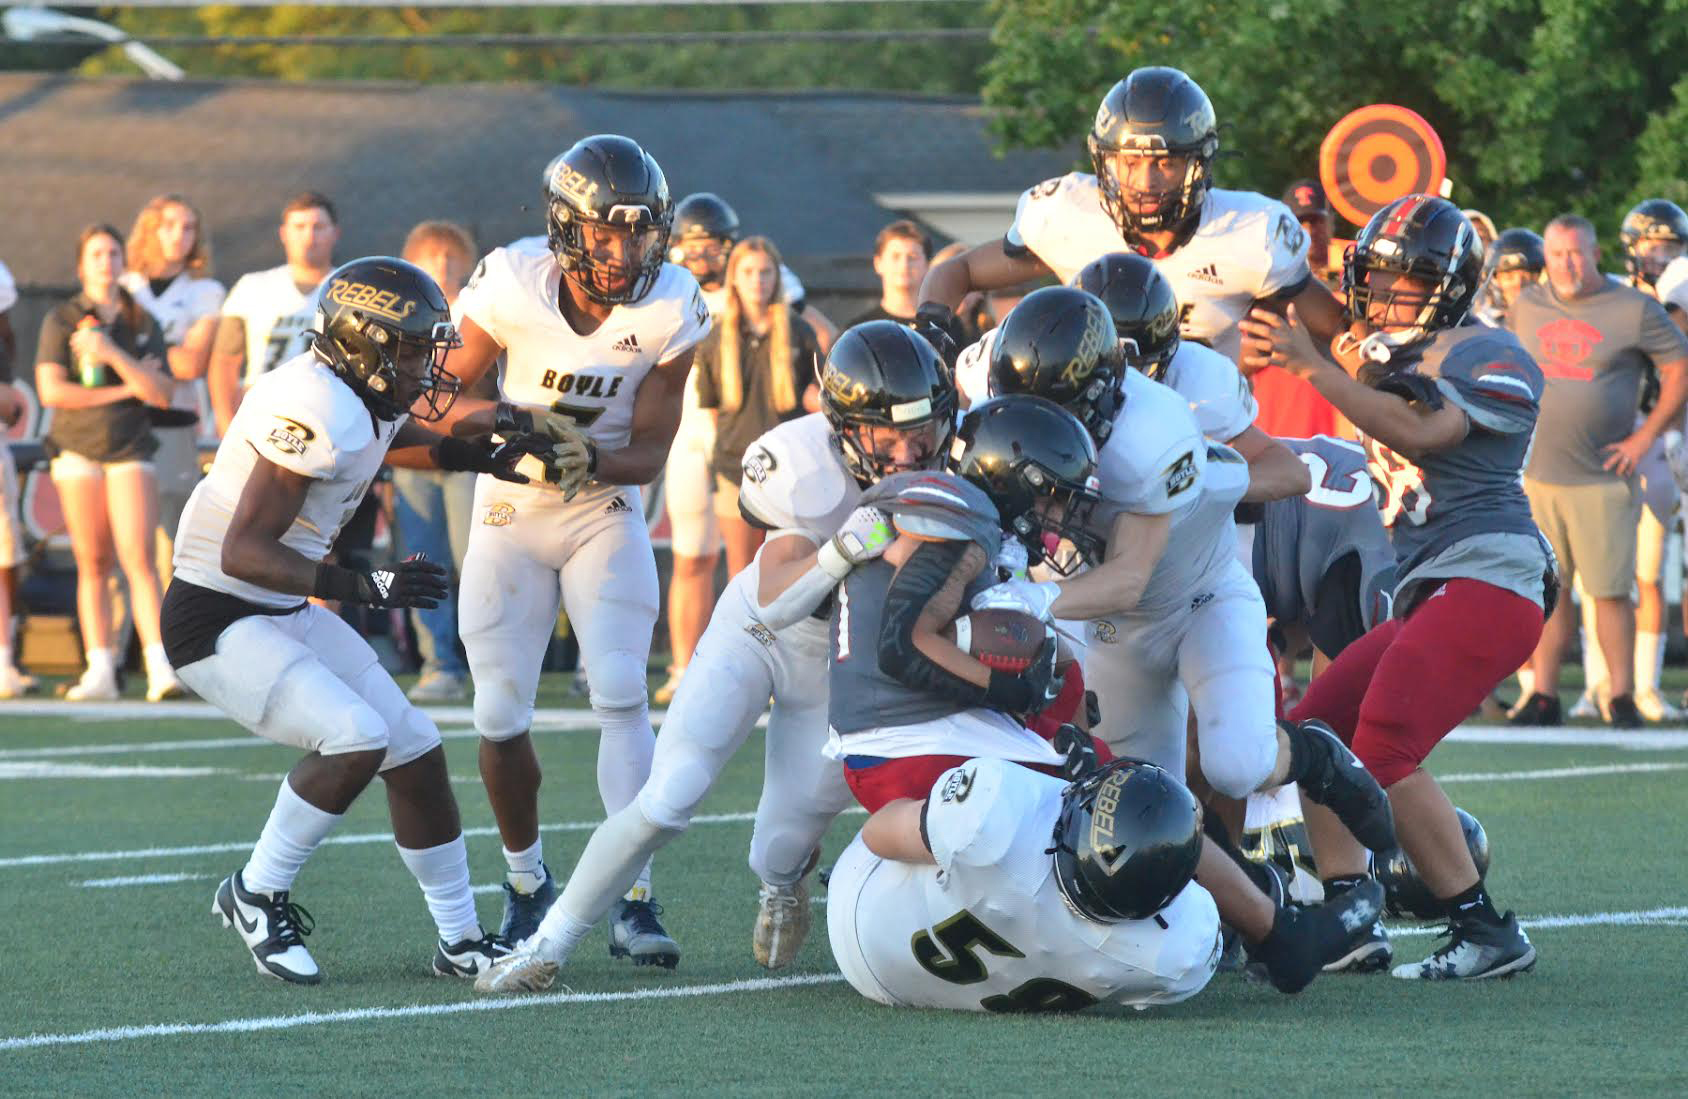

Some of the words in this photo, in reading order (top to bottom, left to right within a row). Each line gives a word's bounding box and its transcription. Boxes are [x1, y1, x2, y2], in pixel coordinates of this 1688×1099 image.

[326, 279, 416, 322] REBELS
[1061, 298, 1107, 390] REBEL
[541, 369, 624, 398] BOYLE
[371, 571, 389, 599] adidas
[1090, 768, 1136, 857] REBELS
